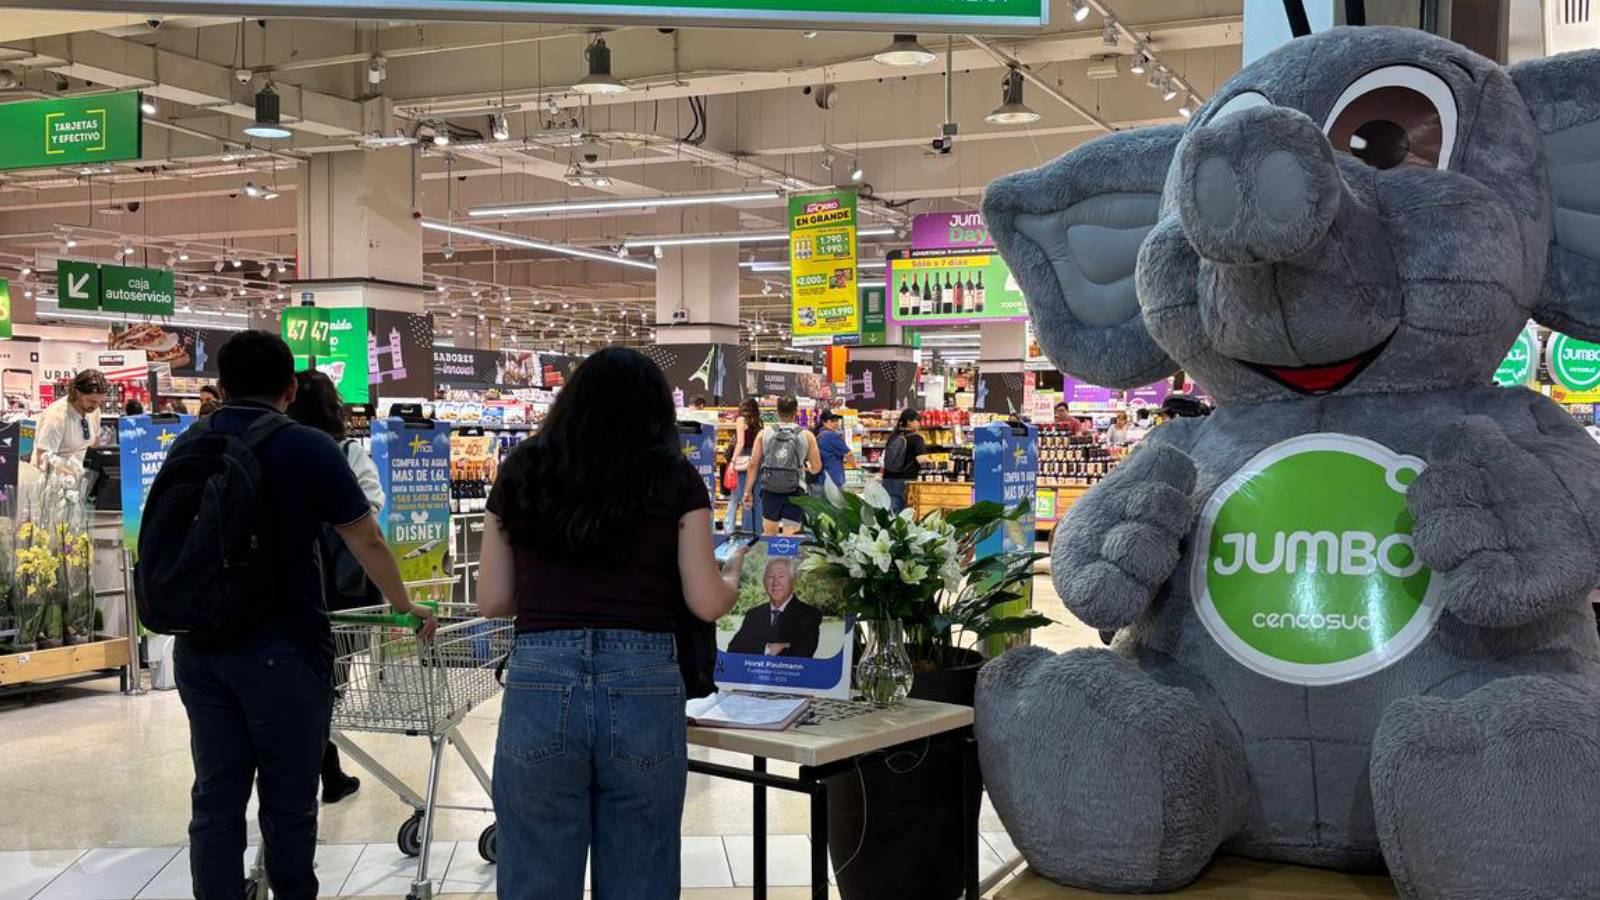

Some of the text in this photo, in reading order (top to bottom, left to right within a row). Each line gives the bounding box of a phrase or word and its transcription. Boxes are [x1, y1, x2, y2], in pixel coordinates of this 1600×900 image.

[54, 119, 98, 131] TARJETAS
[52, 131, 100, 144] Y EFECTIVO
[796, 210, 849, 227] EN GRANDE
[949, 213, 981, 227] JUM
[128, 277, 150, 292] caja
[105, 289, 171, 304] autoservicio
[287, 319, 307, 340] 47
[311, 320, 329, 341] 47
[433, 352, 474, 364] SABORES
[141, 462, 162, 475] MAS
[391, 458, 448, 468] COMPRA TU AGUA
[391, 469, 413, 481] MAS
[416, 469, 428, 481] DE
[1003, 484, 1017, 500] MAS
[396, 522, 442, 542] DISNEY
[1214, 530, 1424, 578] JUMBO
[744, 659, 804, 670] Horst Paulmann
